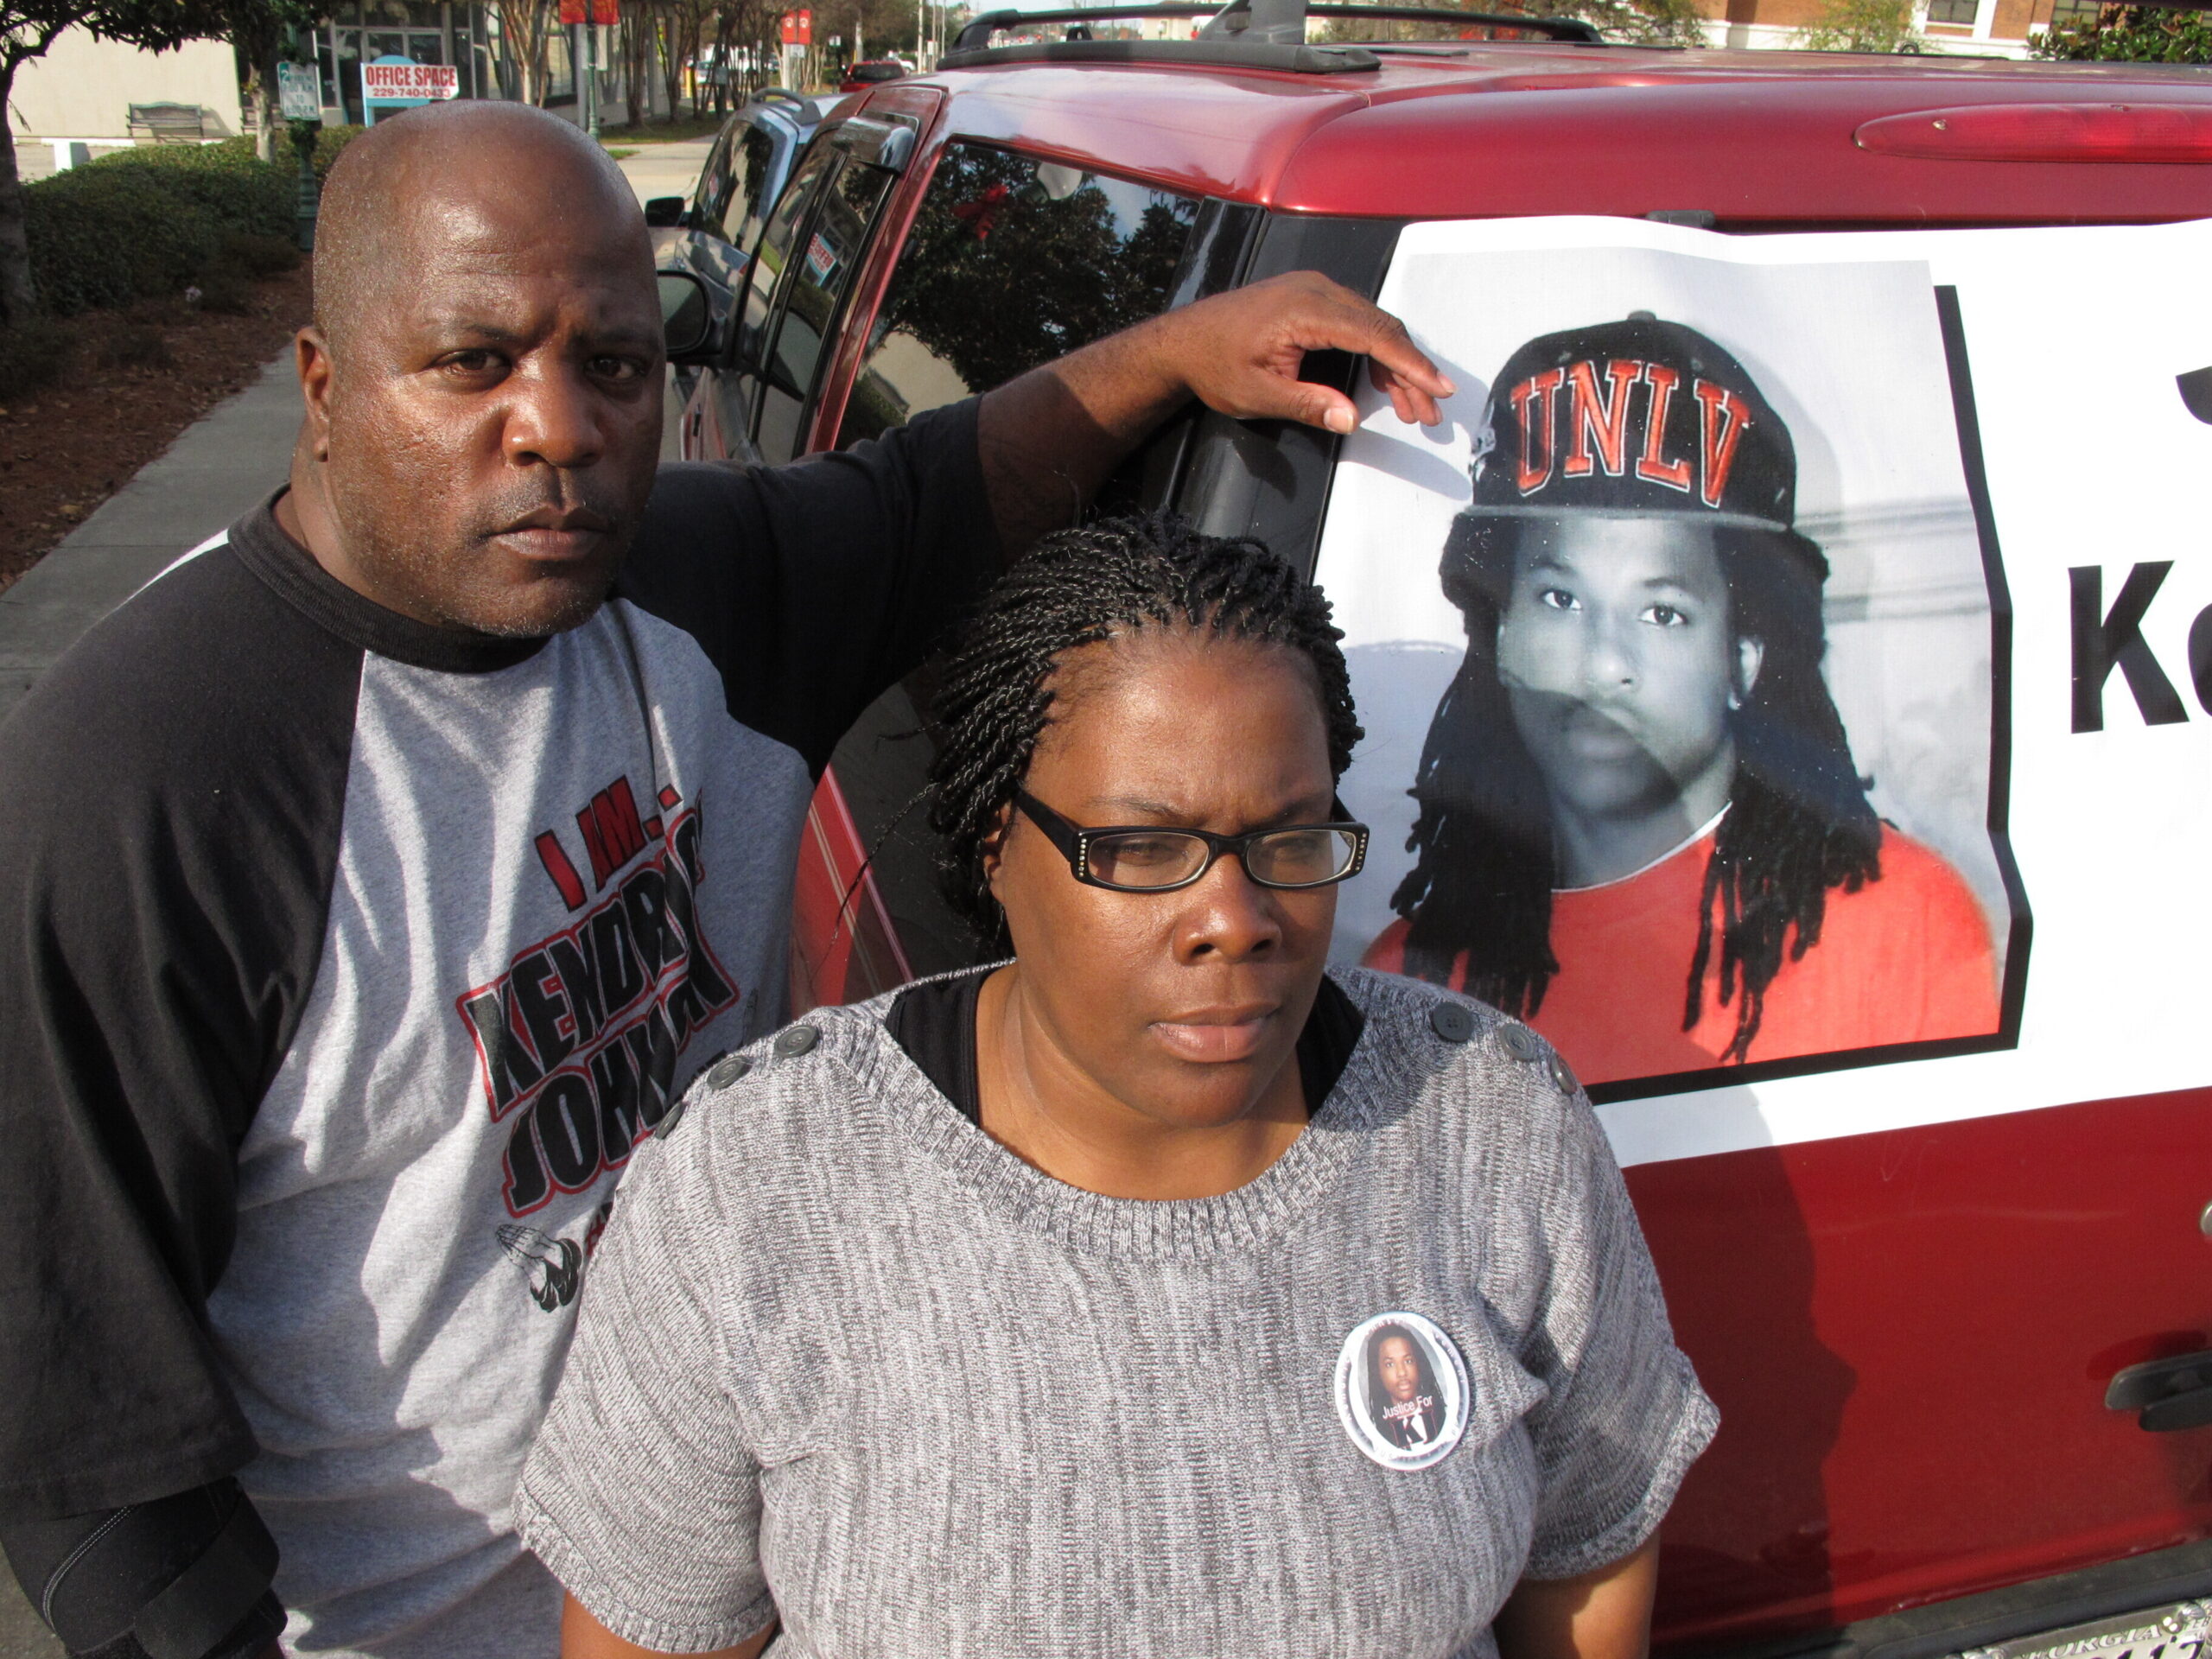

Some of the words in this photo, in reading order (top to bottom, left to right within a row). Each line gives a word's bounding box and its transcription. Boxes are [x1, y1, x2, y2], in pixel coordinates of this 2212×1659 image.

[366, 66, 411, 86] OFFICE
[415, 67, 455, 86] SPACE
[372, 87, 450, 98] 229-740-0433
[1510, 359, 1751, 509] UNLV
[534, 829, 588, 912] I
[1382, 1401, 1415, 1420] Justice
[1416, 1395, 1433, 1408] For
[2022, 1624, 2162, 1659] ORGIA
